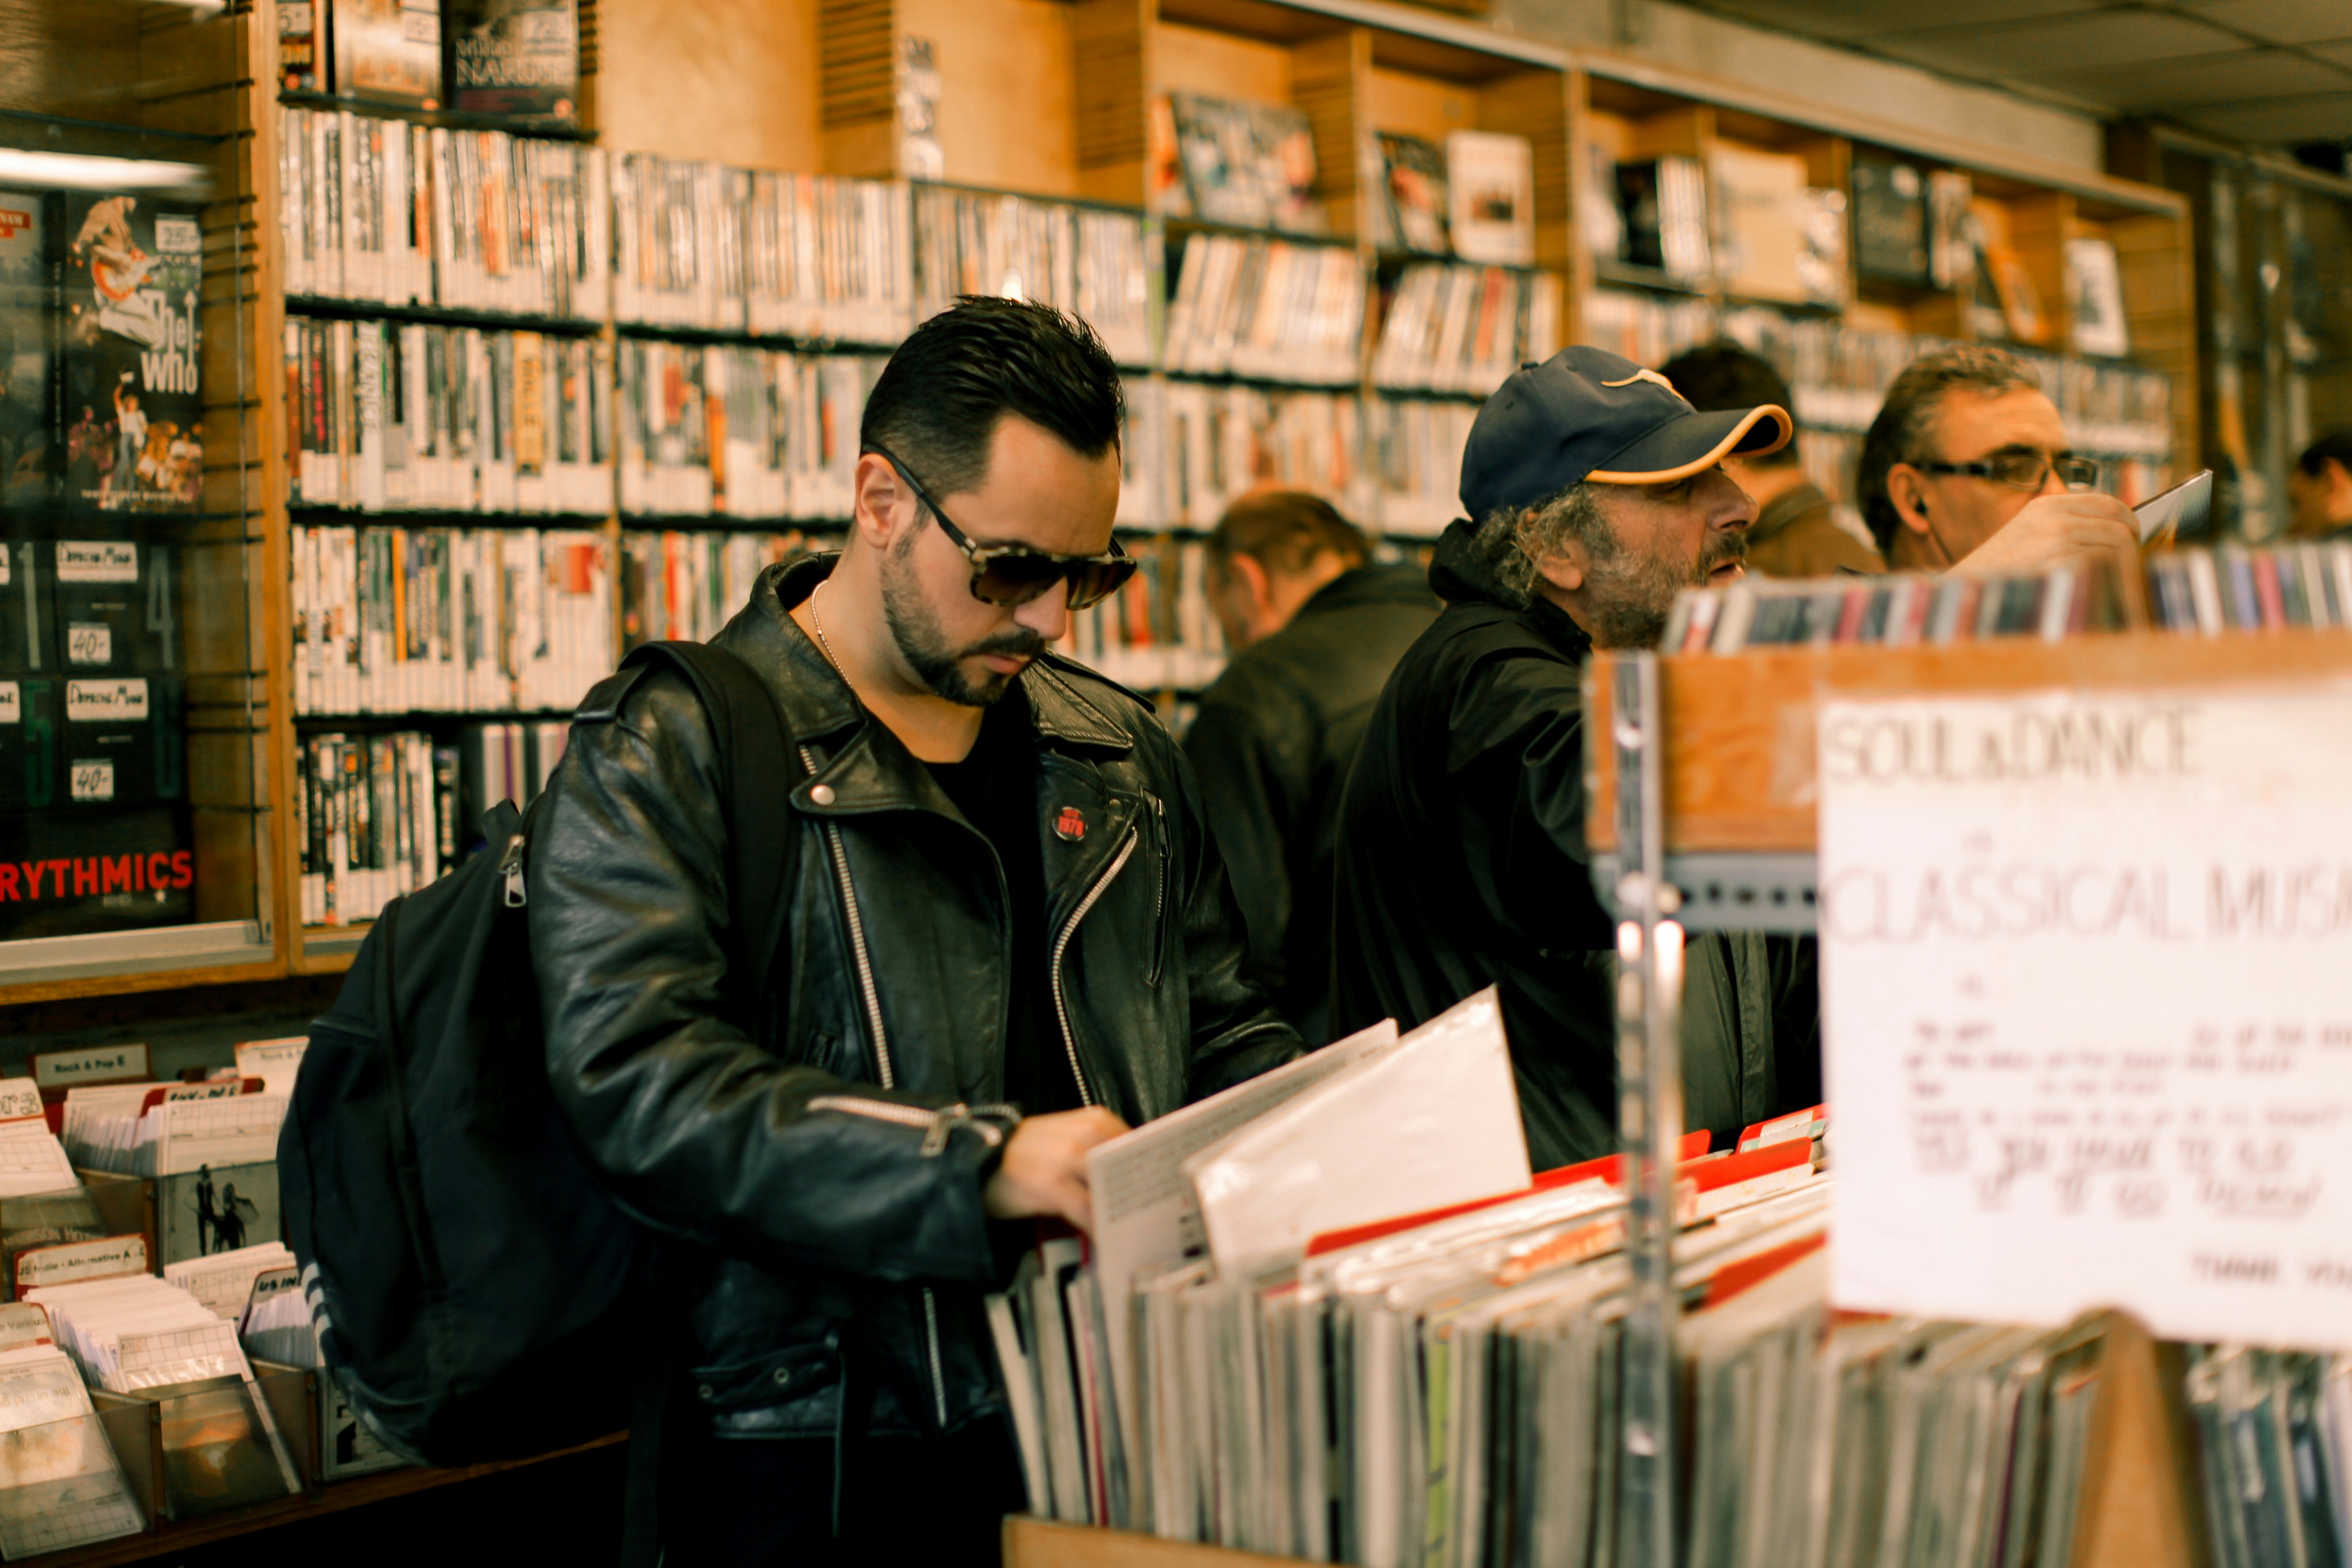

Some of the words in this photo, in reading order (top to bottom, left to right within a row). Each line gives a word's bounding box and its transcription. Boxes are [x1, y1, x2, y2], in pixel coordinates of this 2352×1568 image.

[2008, 704, 2203, 779] DANCE
[0, 850, 193, 903] RYTHMICS
[1825, 861, 2199, 943] CLASSICAL
